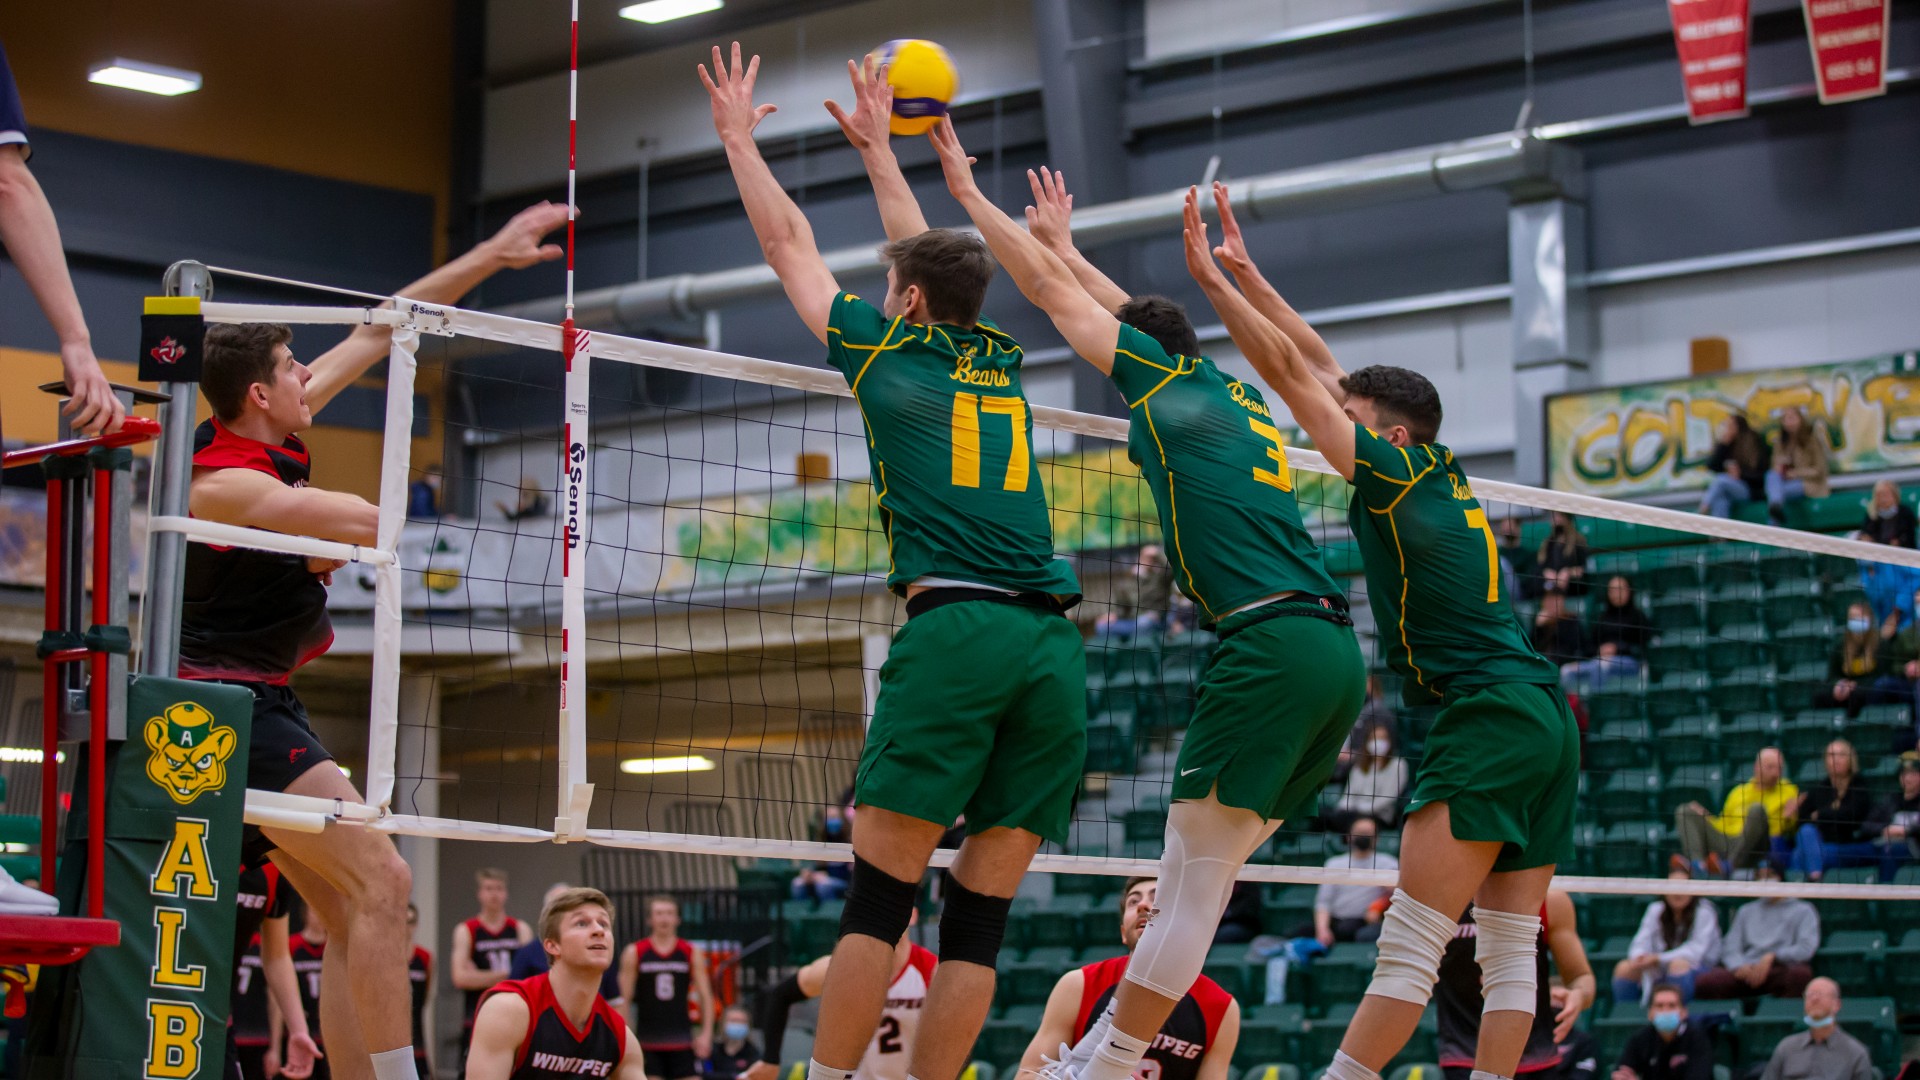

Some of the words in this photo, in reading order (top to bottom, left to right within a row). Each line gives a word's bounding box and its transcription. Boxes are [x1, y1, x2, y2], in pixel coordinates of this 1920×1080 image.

[419, 307, 445, 317] Senoh
[949, 356, 1010, 387] Bears
[952, 391, 1029, 492] 17
[1248, 416, 1293, 493] 3
[568, 466, 582, 549] Senoh
[181, 730, 193, 747] A
